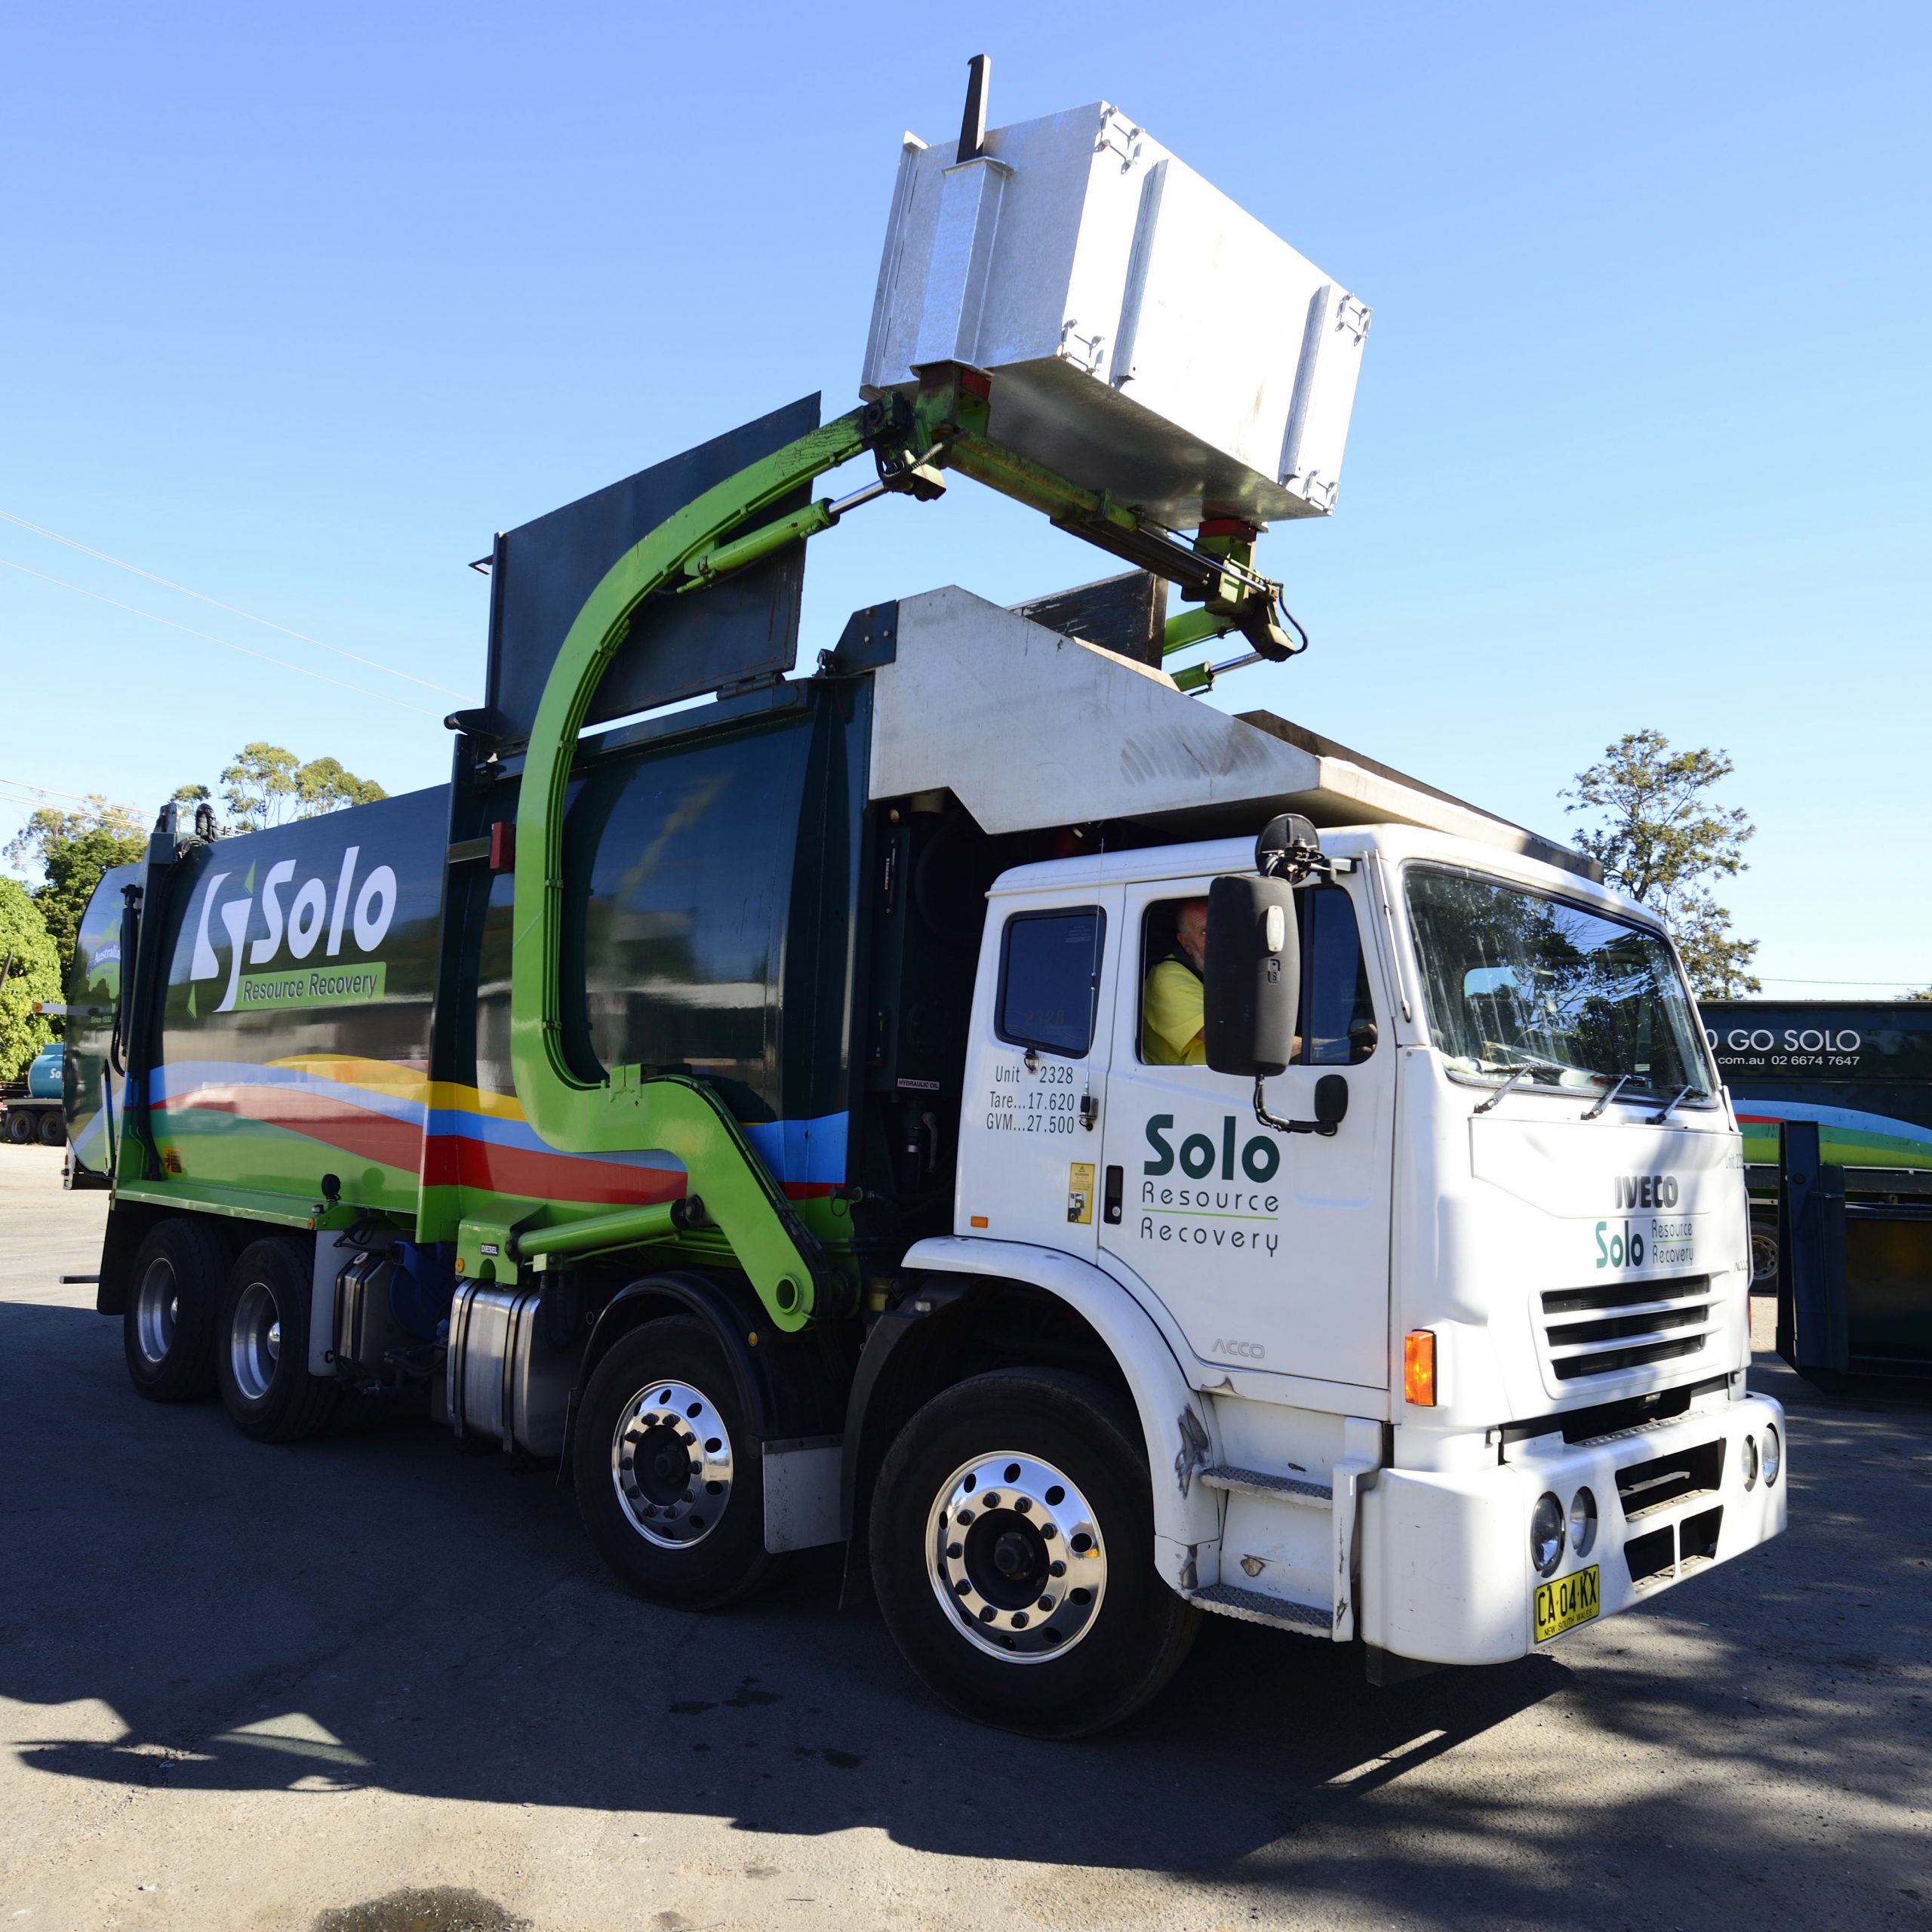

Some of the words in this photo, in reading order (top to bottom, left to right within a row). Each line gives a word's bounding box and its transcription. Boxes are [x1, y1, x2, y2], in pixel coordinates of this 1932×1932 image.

[250, 845, 397, 965] Solo
[242, 980, 303, 1002] Resource
[308, 972, 378, 1000] Recovery
[1727, 1029, 1774, 1051] GO
[1784, 1029, 1861, 1051] SOLO
[995, 1065, 1020, 1083] Unit
[1039, 1066, 1074, 1084] 2328
[1771, 1056, 1788, 1065] 02
[1791, 1056, 1823, 1065] 6674
[1828, 1056, 1860, 1066] 7647
[1143, 1113, 1281, 1183] Solo
[1142, 1180, 1279, 1213] Resource
[1615, 1175, 1678, 1209] IVECO
[1140, 1216, 1278, 1258] Recovery
[1651, 1220, 1693, 1238] Resource
[481, 1244, 498, 1254] DIESEL
[1595, 1220, 1644, 1269] Solo
[1652, 1244, 1694, 1266] Recovery
[1211, 1338, 1266, 1359] ACCO
[1544, 1626, 1555, 1636] NEW
[1558, 1617, 1574, 1631] SOUTH
[1577, 1608, 1592, 1622] WALES
